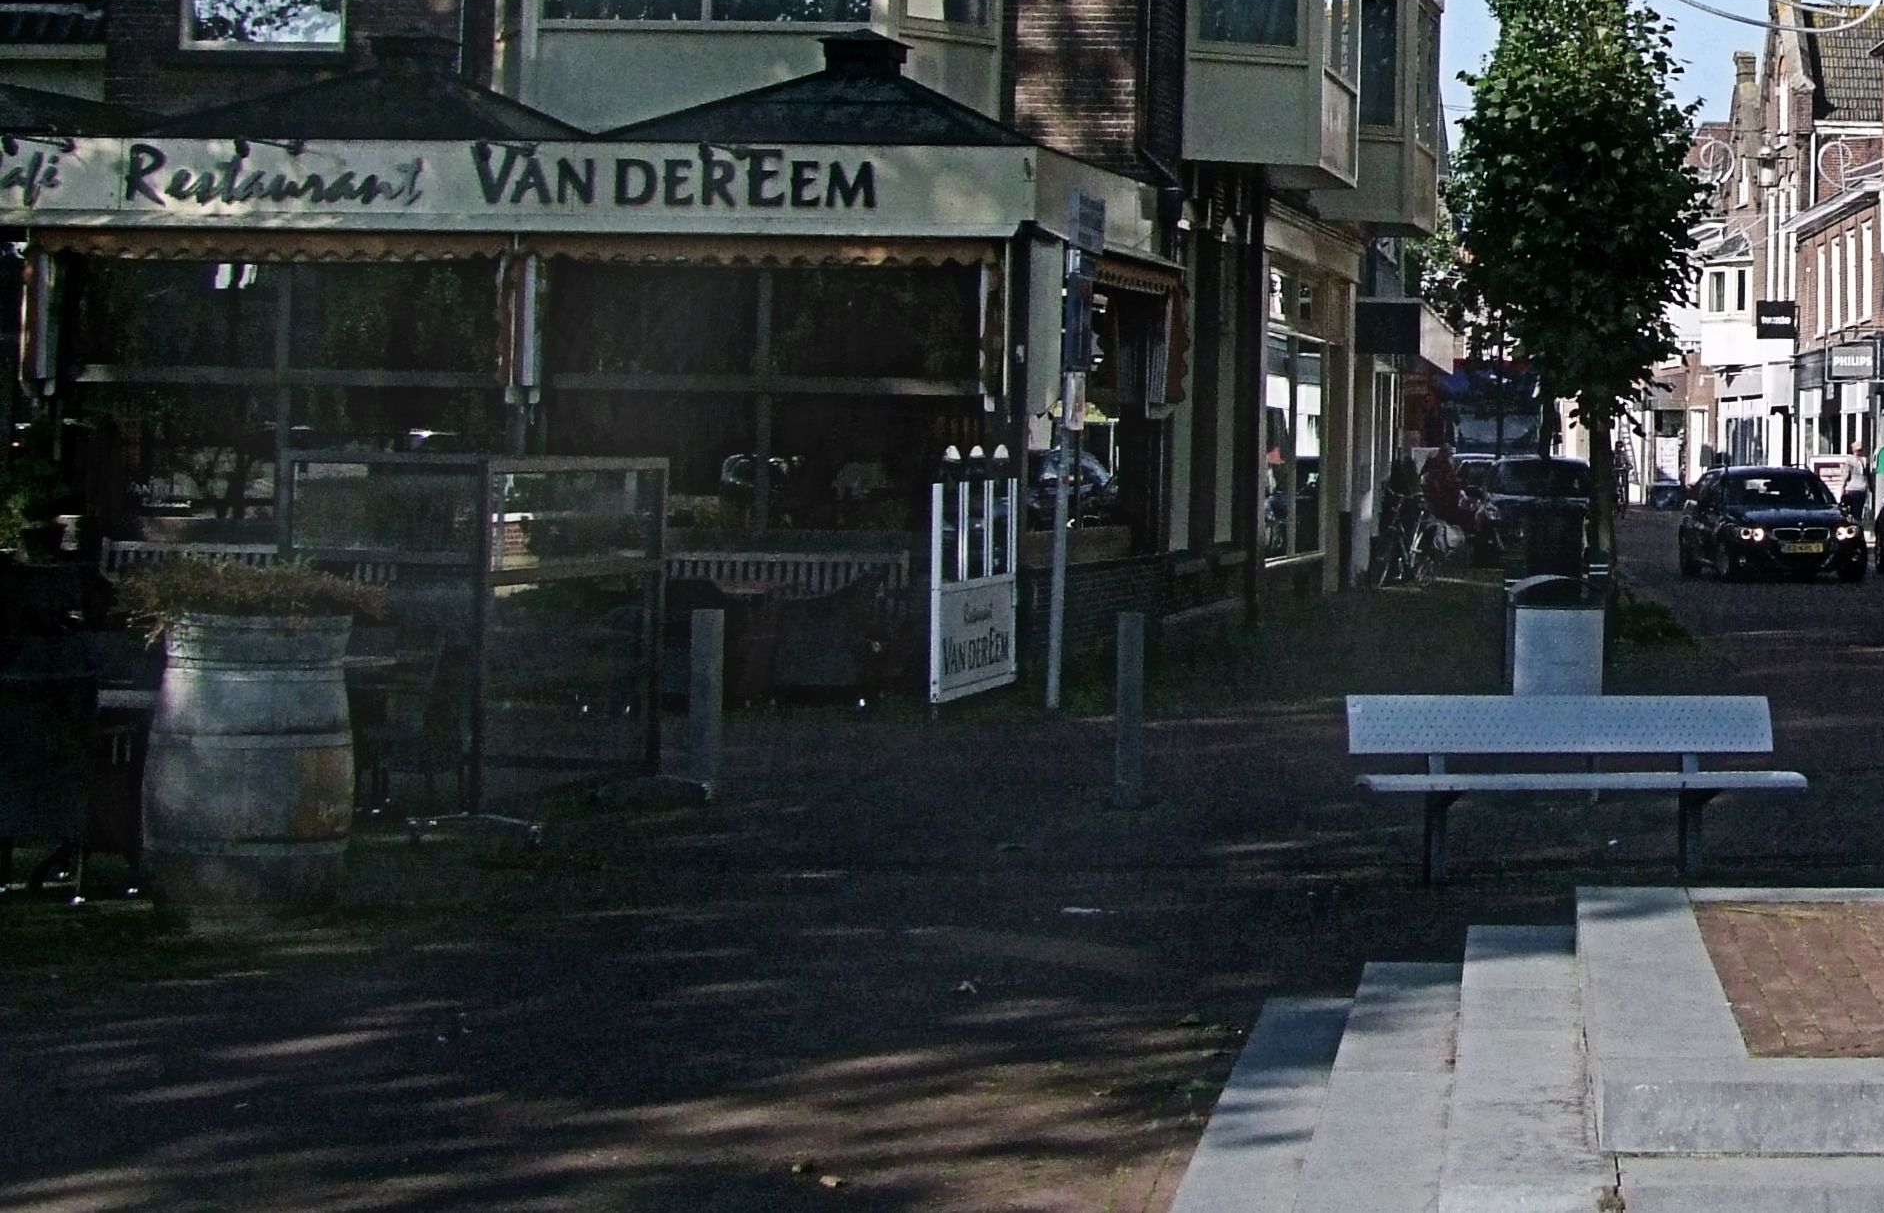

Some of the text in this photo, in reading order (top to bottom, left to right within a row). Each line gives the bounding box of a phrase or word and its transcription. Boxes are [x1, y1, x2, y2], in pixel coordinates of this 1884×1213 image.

[0, 150, 61, 208] afé
[125, 142, 427, 208] Restaurant
[470, 142, 596, 205] VAN
[1833, 356, 1873, 367] PHILIPS
